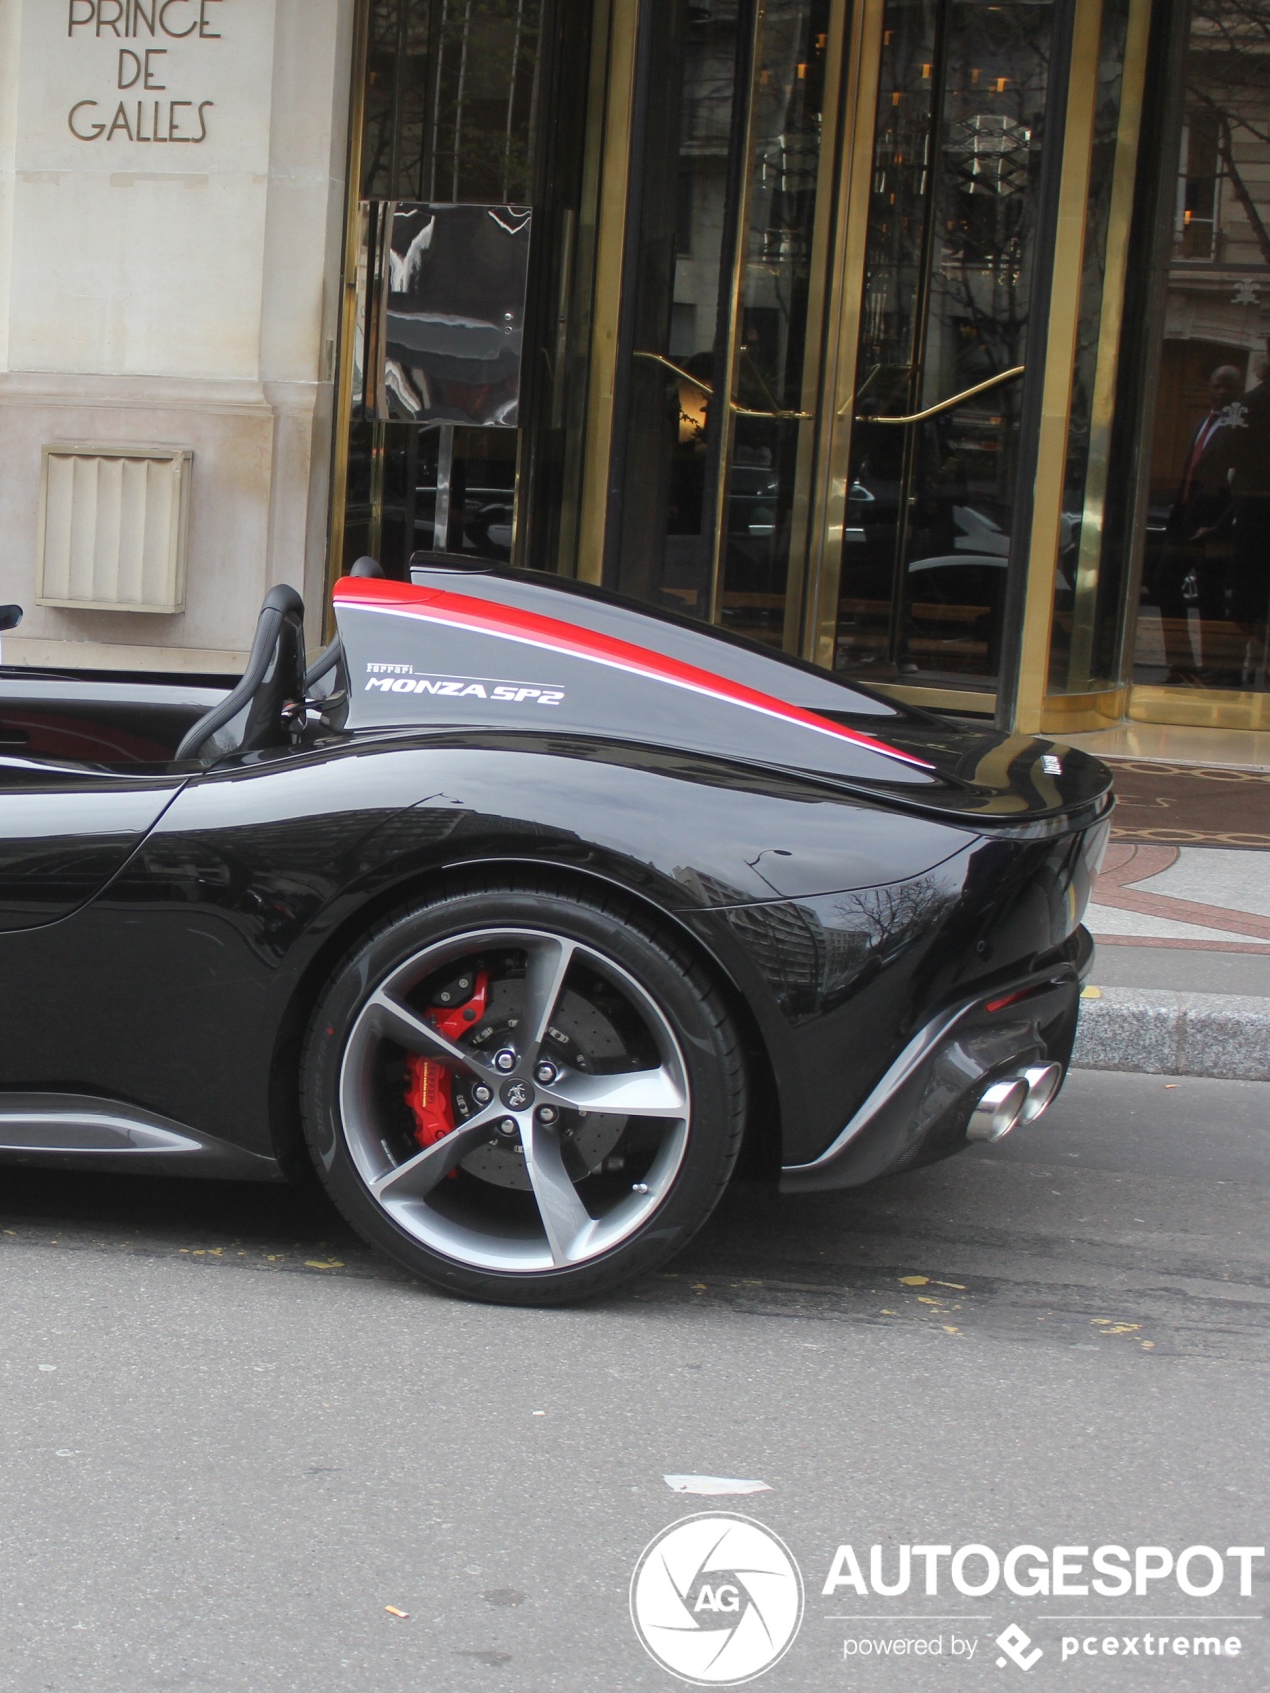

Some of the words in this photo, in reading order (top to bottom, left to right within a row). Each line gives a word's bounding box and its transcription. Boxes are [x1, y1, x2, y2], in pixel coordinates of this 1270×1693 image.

[68, 0, 222, 38] PRINCE
[117, 48, 167, 90] DE
[67, 99, 214, 143] GALLES
[366, 662, 414, 675] Ferrari
[364, 677, 488, 699] MONZA
[490, 685, 565, 706] SP2
